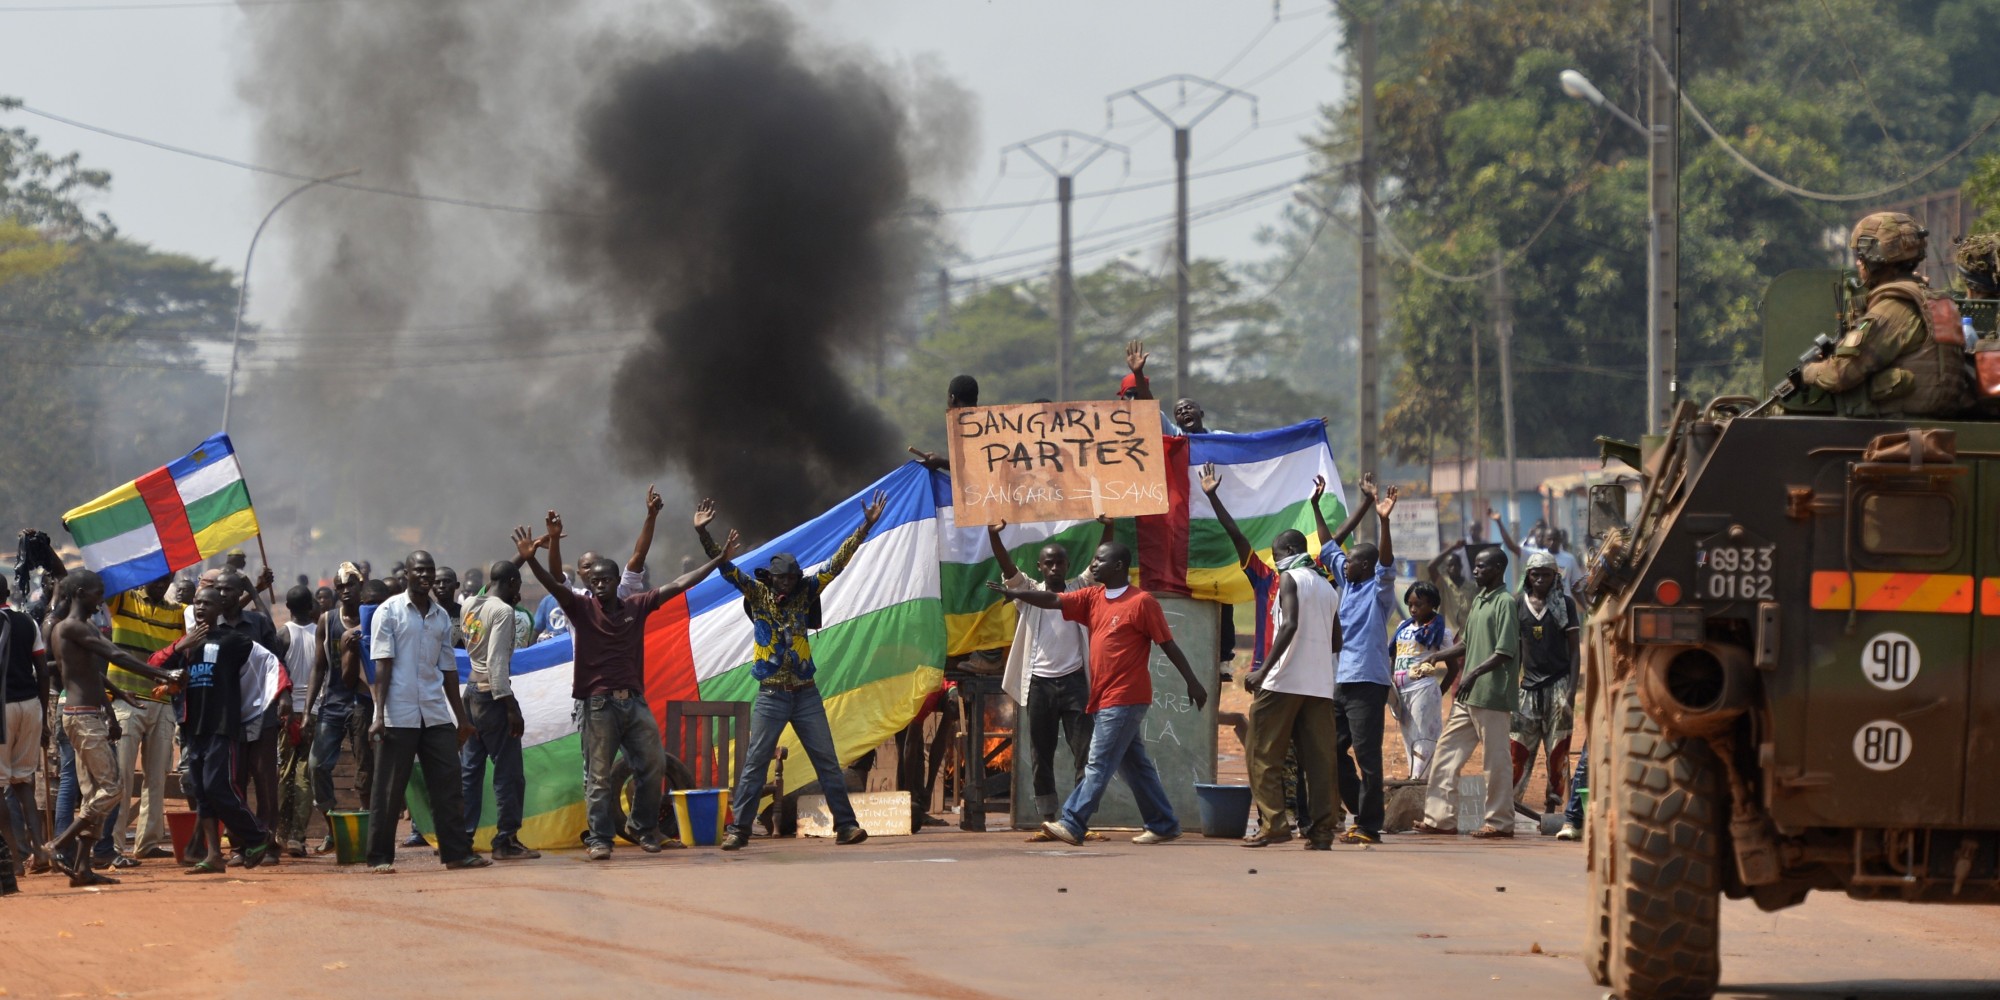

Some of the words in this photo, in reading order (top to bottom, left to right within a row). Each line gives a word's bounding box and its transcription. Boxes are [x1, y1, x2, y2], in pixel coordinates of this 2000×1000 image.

[958, 409, 1136, 438] SANGARIS
[980, 438, 1149, 472] PARTEZ
[964, 483, 1064, 506] SANGARIS
[1099, 481, 1163, 505] SANG
[1711, 548, 1773, 572] 6933
[1709, 574, 1774, 600] 0162
[1872, 640, 1911, 683] 90
[1144, 719, 1181, 746] LA
[1863, 726, 1902, 764] 80
